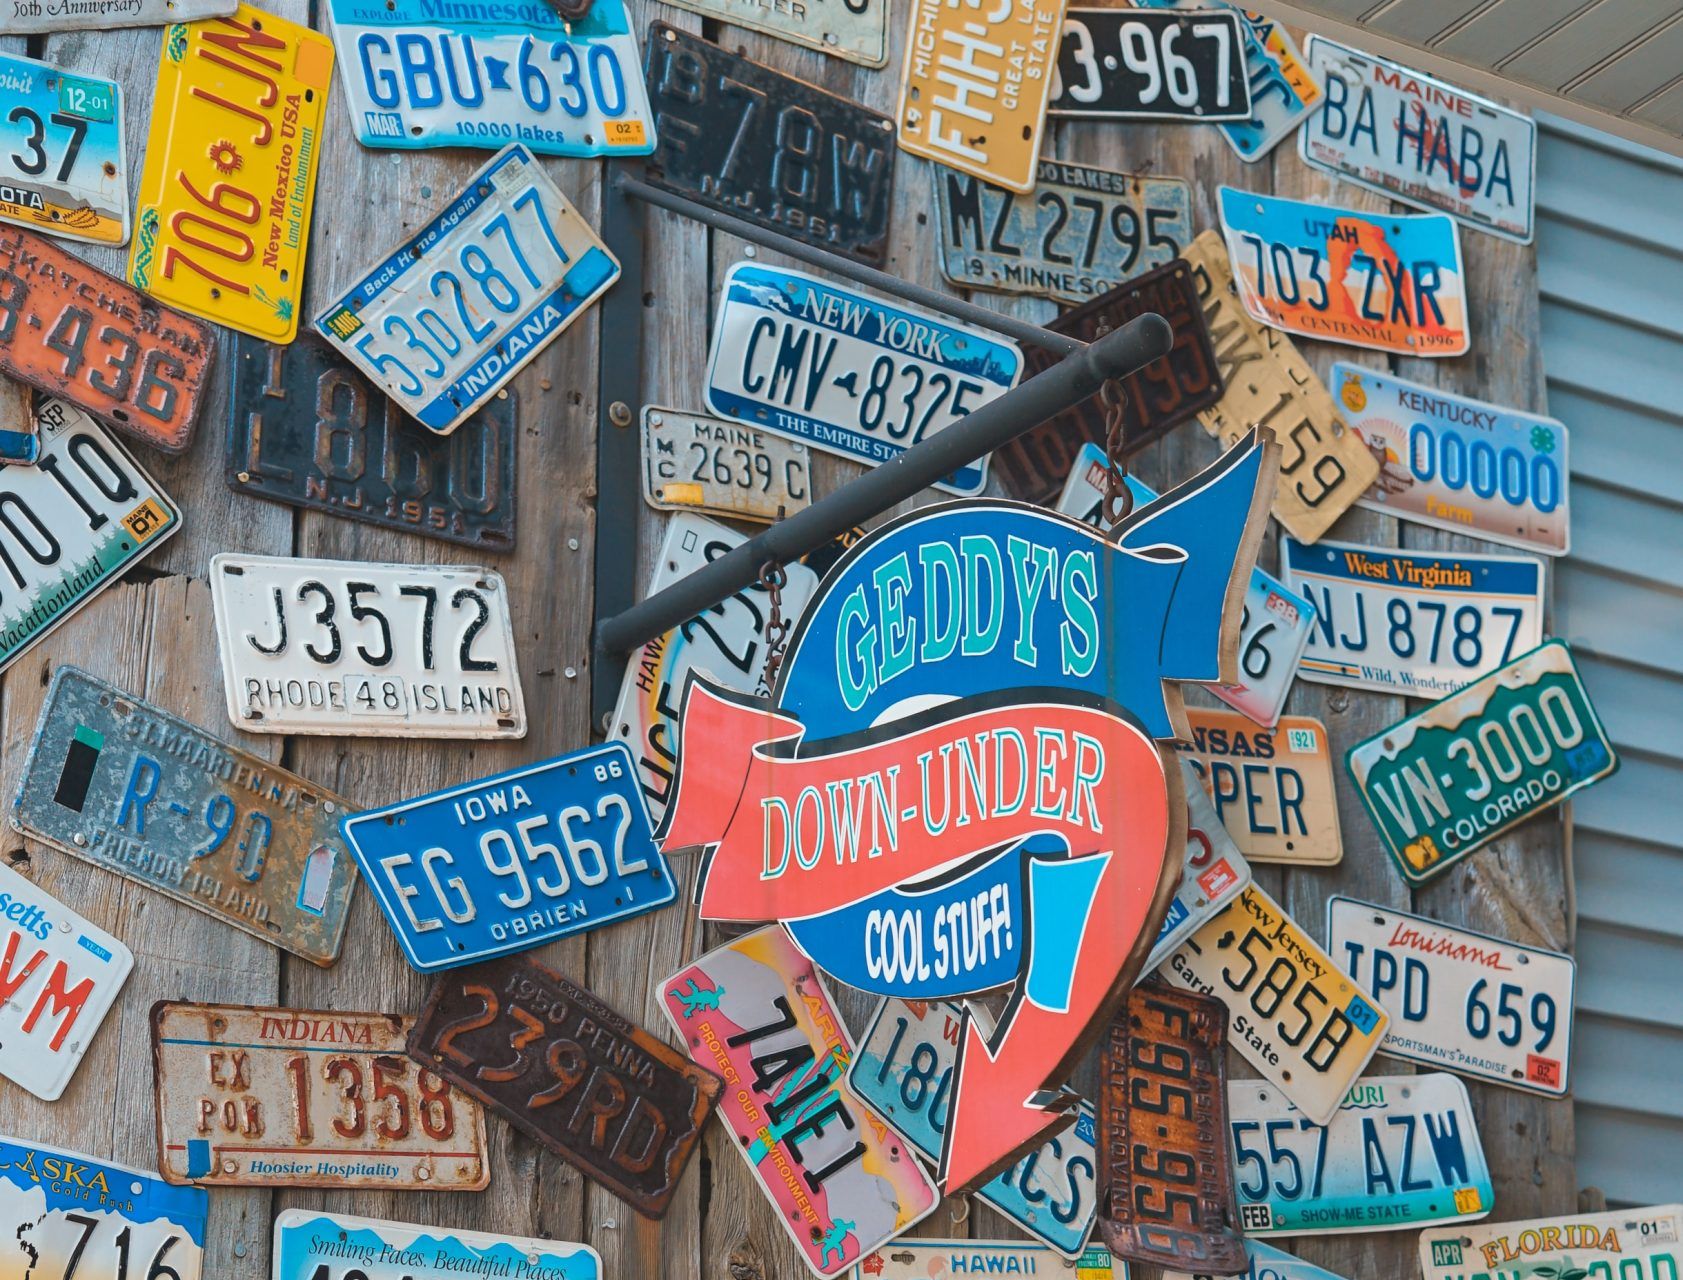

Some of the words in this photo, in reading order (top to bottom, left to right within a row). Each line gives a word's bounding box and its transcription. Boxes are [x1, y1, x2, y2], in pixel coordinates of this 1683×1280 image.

[1026, 11, 1055, 80] STATE
[358, 33, 485, 109] GBU
[518, 35, 627, 118] 630
[1002, 40, 1027, 110] GREAT
[1374, 66, 1473, 119] MAINE
[367, 114, 402, 137] MAR
[456, 121, 511, 138] 10,000
[516, 121, 565, 143] lakes
[1397, 99, 1515, 208] HABA
[262, 214, 287, 271] New
[280, 92, 303, 139] USA
[163, 170, 262, 297] 706
[283, 211, 304, 250] Land
[363, 267, 398, 298] Back
[440, 196, 478, 232] Again
[1038, 191, 1182, 275] 2795
[1303, 217, 1359, 245] UTAH
[1241, 234, 1329, 312] 703
[1353, 254, 1446, 327] ZXR
[799, 288, 871, 336] NEW
[876, 310, 952, 363] YORK
[1300, 314, 1399, 344] CENTENNIAL
[461, 303, 562, 399] INDIANA
[741, 316, 838, 413] CMV
[39, 403, 64, 433] SEP
[775, 412, 810, 435] THE
[812, 424, 871, 453] EMPIRE
[1397, 389, 1498, 432] KENTUCKY
[694, 422, 764, 450] MAINE
[1425, 495, 1474, 524] Farm
[1343, 551, 1389, 580] West
[1394, 558, 1473, 589] Virginia
[246, 580, 499, 672] J3572
[835, 533, 1099, 712] GEDDY'S
[1386, 598, 1523, 669] 8787
[245, 677, 346, 711] RHODE
[411, 684, 513, 715] ISLAND
[1360, 665, 1396, 687] Wild,
[593, 760, 624, 782] 86
[117, 754, 273, 886] R-90
[453, 784, 533, 827] IOWA
[759, 725, 1106, 882] DOWN-UNDER
[1441, 769, 1562, 849] COLORADO
[380, 846, 477, 933] EG
[478, 792, 650, 909] 9562
[489, 898, 590, 941] O'BRIEN
[865, 909, 930, 984] COOL
[933, 882, 1013, 979] STUFF!
[1236, 888, 1274, 930] New
[1267, 919, 1328, 982] Jersey
[1388, 922, 1513, 971] Louisiana
[259, 1016, 375, 1045] INDIANA
[1465, 977, 1557, 1053] 659
[1232, 1015, 1280, 1066] State
[1457, 1051, 1508, 1074] PARADISE
[430, 984, 668, 1175] 239RD
[697, 1021, 741, 1087] PROTECT
[736, 1089, 761, 1124] OUR
[755, 1126, 821, 1225] ENVIRONMENT
[250, 1159, 313, 1177] Hoosier
[316, 1161, 400, 1180] Hospitality
[1232, 1119, 1328, 1201] 557
[1360, 1110, 1469, 1196] AZW
[51, 1181, 90, 1201] Gold
[99, 1193, 135, 1212] Rush
[1242, 1205, 1271, 1228] FEB
[1300, 1206, 1366, 1223] SHOW-ME
[1368, 1203, 1412, 1219] STATE
[377, 1242, 427, 1269] Faces.
[433, 1248, 512, 1279] Beautiful
[950, 1253, 1037, 1275] HAWAII
[1433, 1243, 1463, 1267] APR
[1480, 1224, 1623, 1270] FLORIDA
